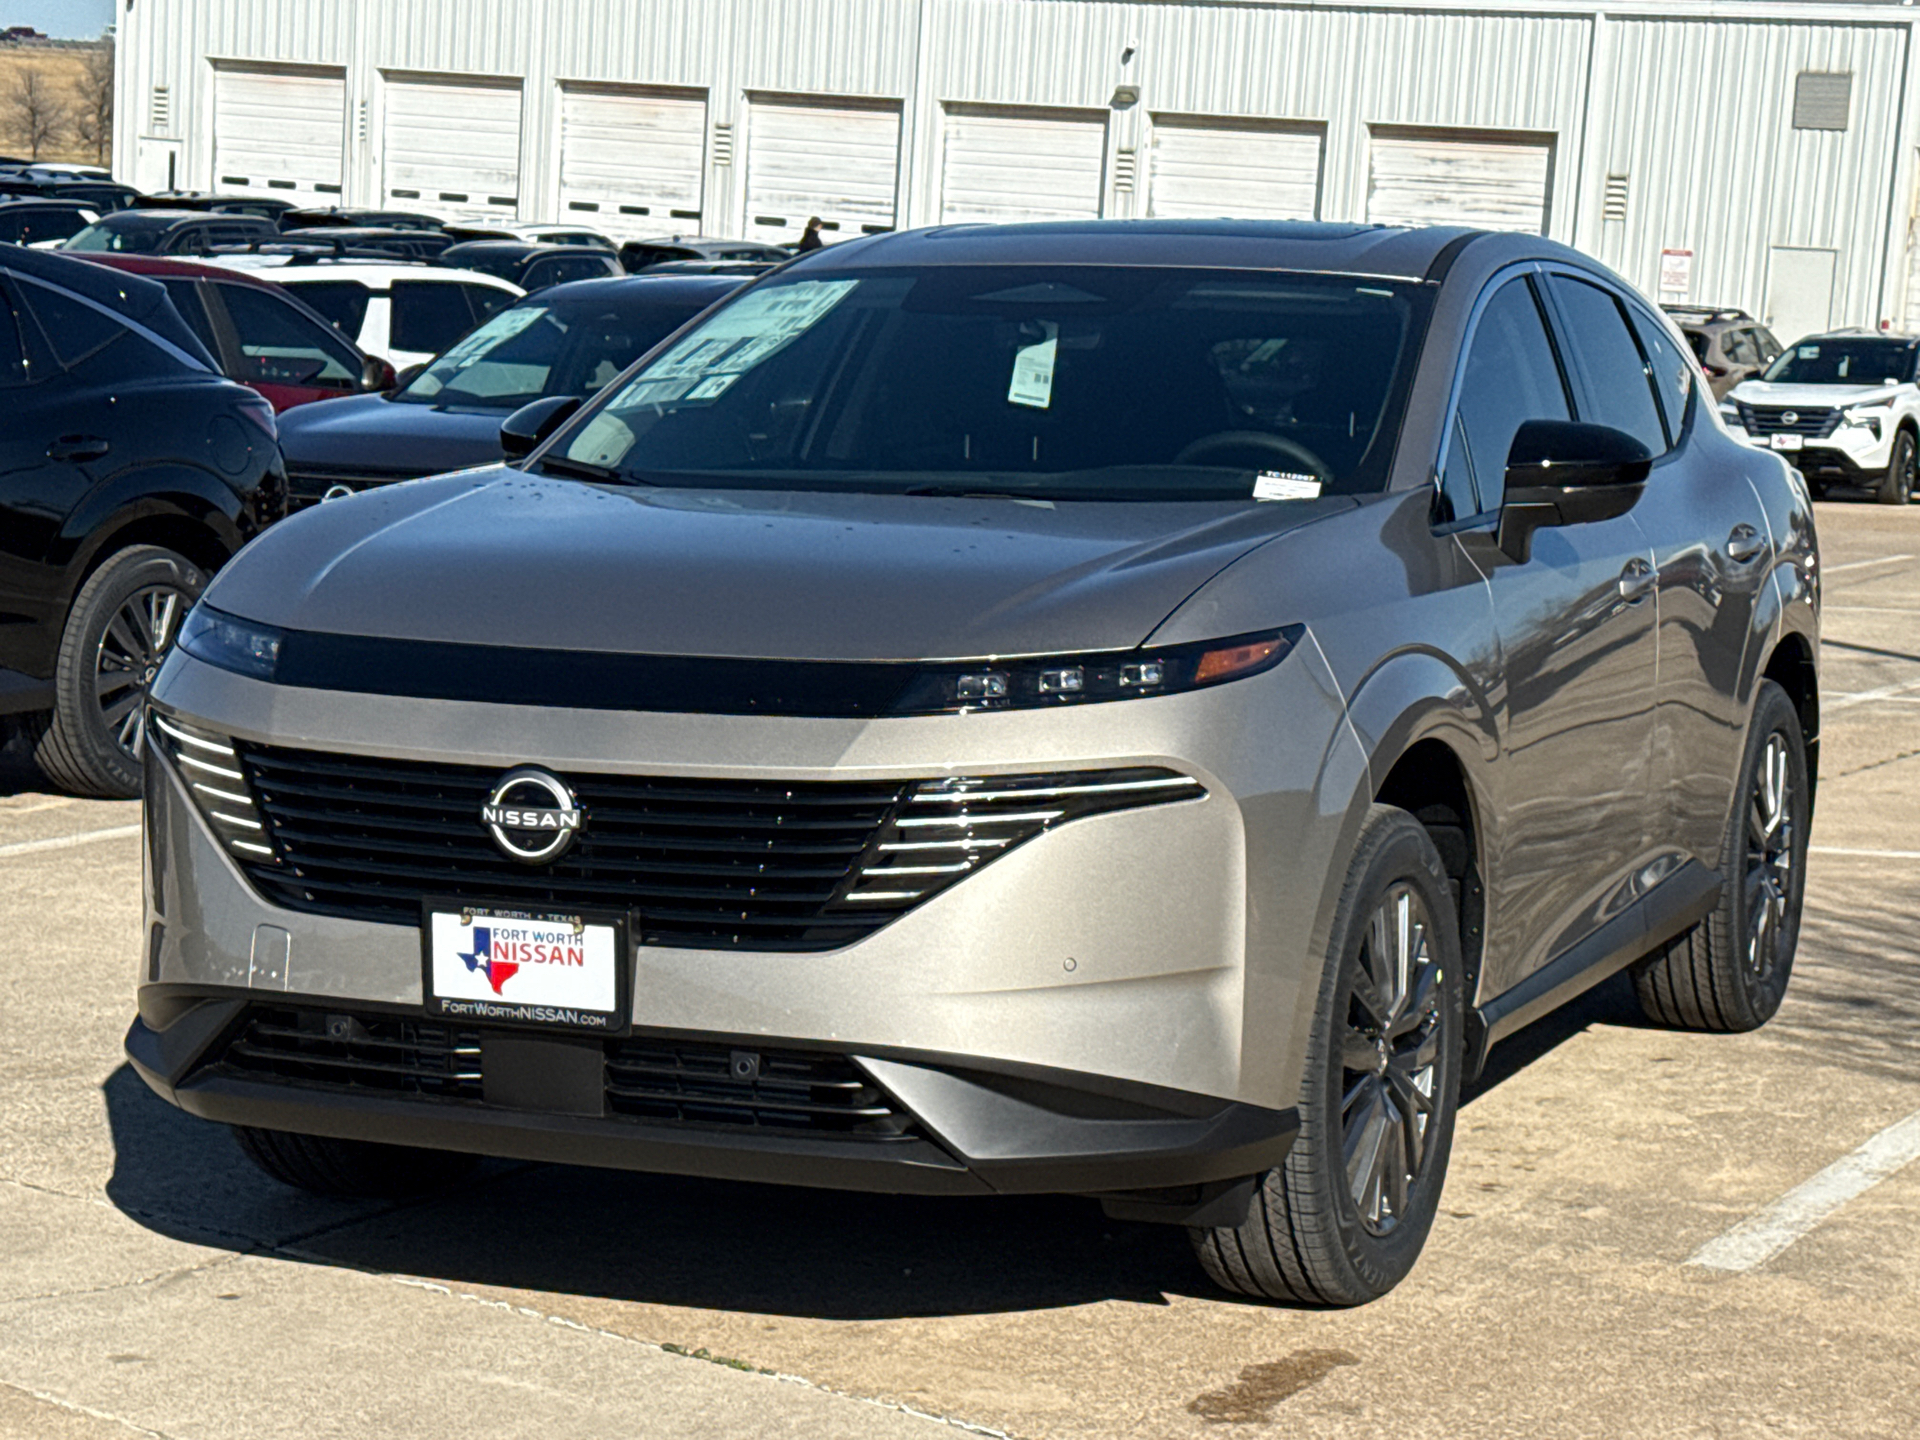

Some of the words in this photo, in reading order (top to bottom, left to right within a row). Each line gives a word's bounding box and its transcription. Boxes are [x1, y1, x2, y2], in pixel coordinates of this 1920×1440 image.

[483, 806, 577, 827] NISSAN
[463, 906, 490, 916] FORT
[494, 909, 532, 919] WORTH
[546, 913, 581, 924] TEXAS
[493, 928, 529, 941] FORT
[532, 931, 583, 946] WORTH
[493, 941, 584, 967] NISSAN
